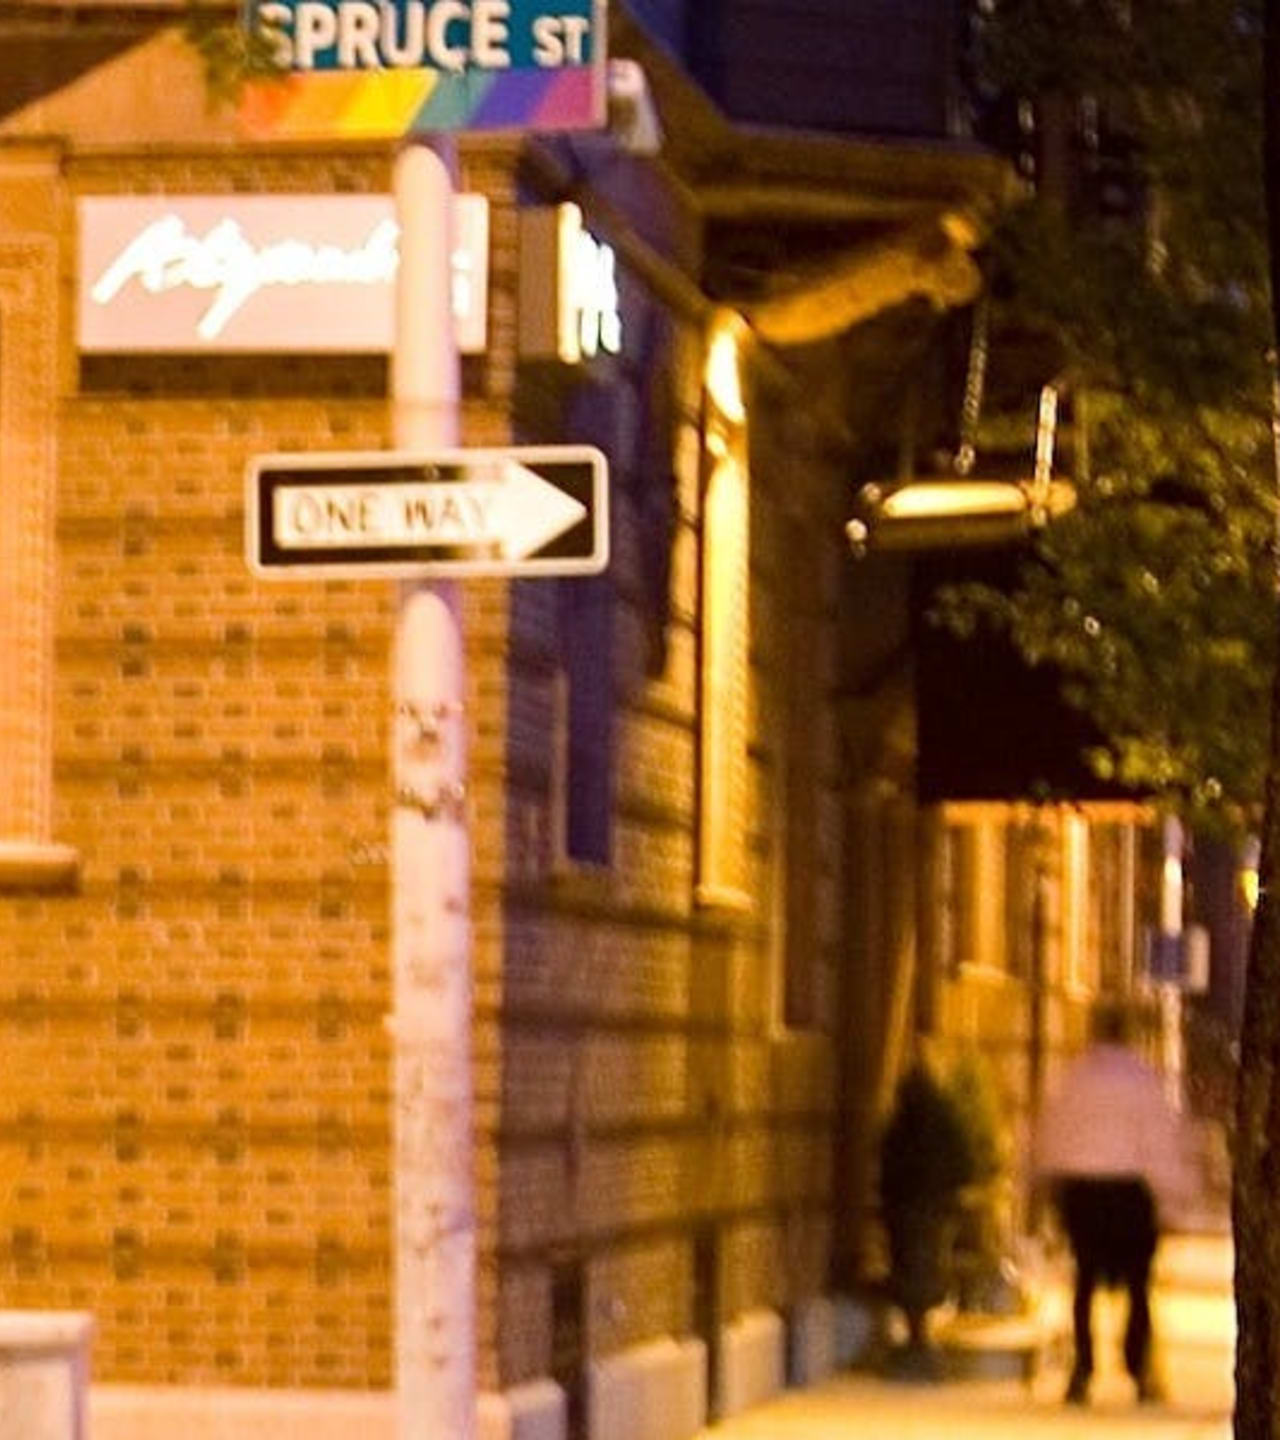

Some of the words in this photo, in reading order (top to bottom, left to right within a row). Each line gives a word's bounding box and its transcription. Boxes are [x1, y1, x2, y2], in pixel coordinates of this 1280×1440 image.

[257, 0, 510, 68] SPRUCE
[531, 15, 589, 68] ST
[293, 493, 378, 534] ONE
[402, 491, 489, 532] WAY
